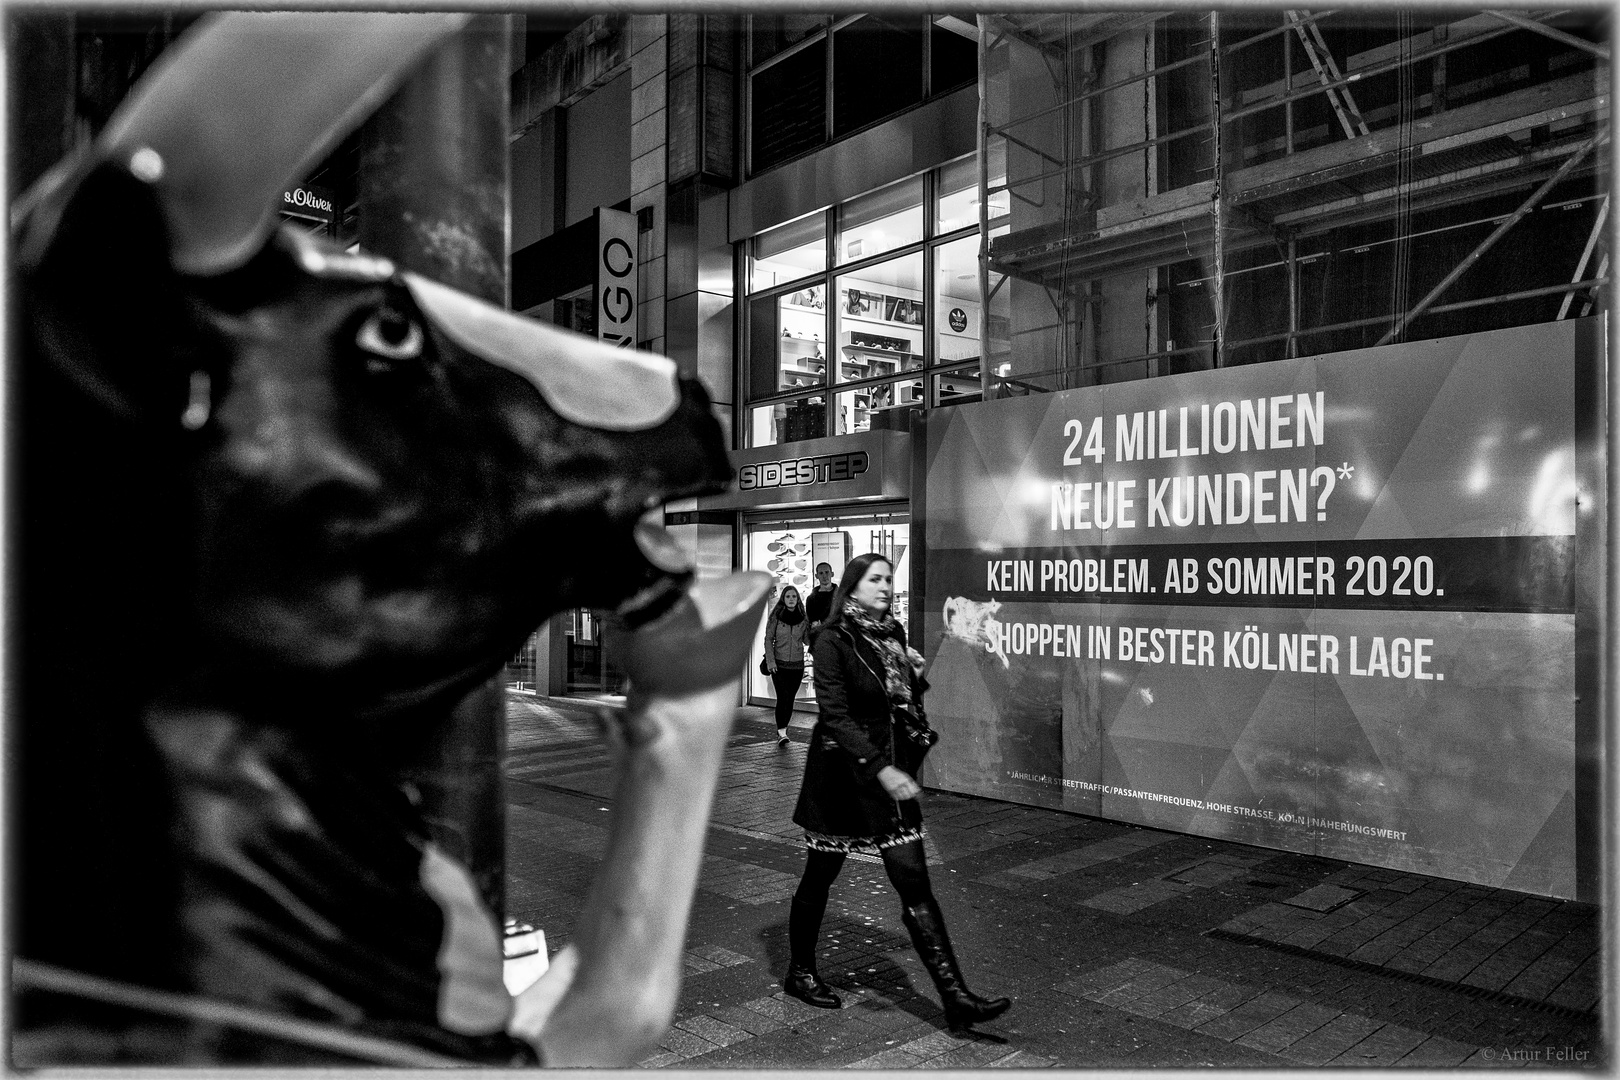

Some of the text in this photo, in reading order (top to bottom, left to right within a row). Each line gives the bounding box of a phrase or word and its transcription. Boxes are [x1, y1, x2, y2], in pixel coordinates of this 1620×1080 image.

[284, 188, 333, 212] s.Oliver
[1063, 391, 1325, 466] 24 MILLIONEN
[740, 451, 870, 490] SIDESTEP
[1050, 479, 1136, 531] NEUE
[987, 555, 1445, 597] KEIN PROBLEM. AB SOMMER 2020.
[985, 622, 1446, 681] SHOPPEN IN BESTER KÖLNER LAGE.
[1053, 778, 1205, 809] STREETTRAFFIC/PASSANTENFREQUENZ,
[1206, 803, 1232, 813] HOHE
[1233, 806, 1276, 820] STRASSE,
[1312, 817, 1407, 841] NÄHERUNGSWERT
